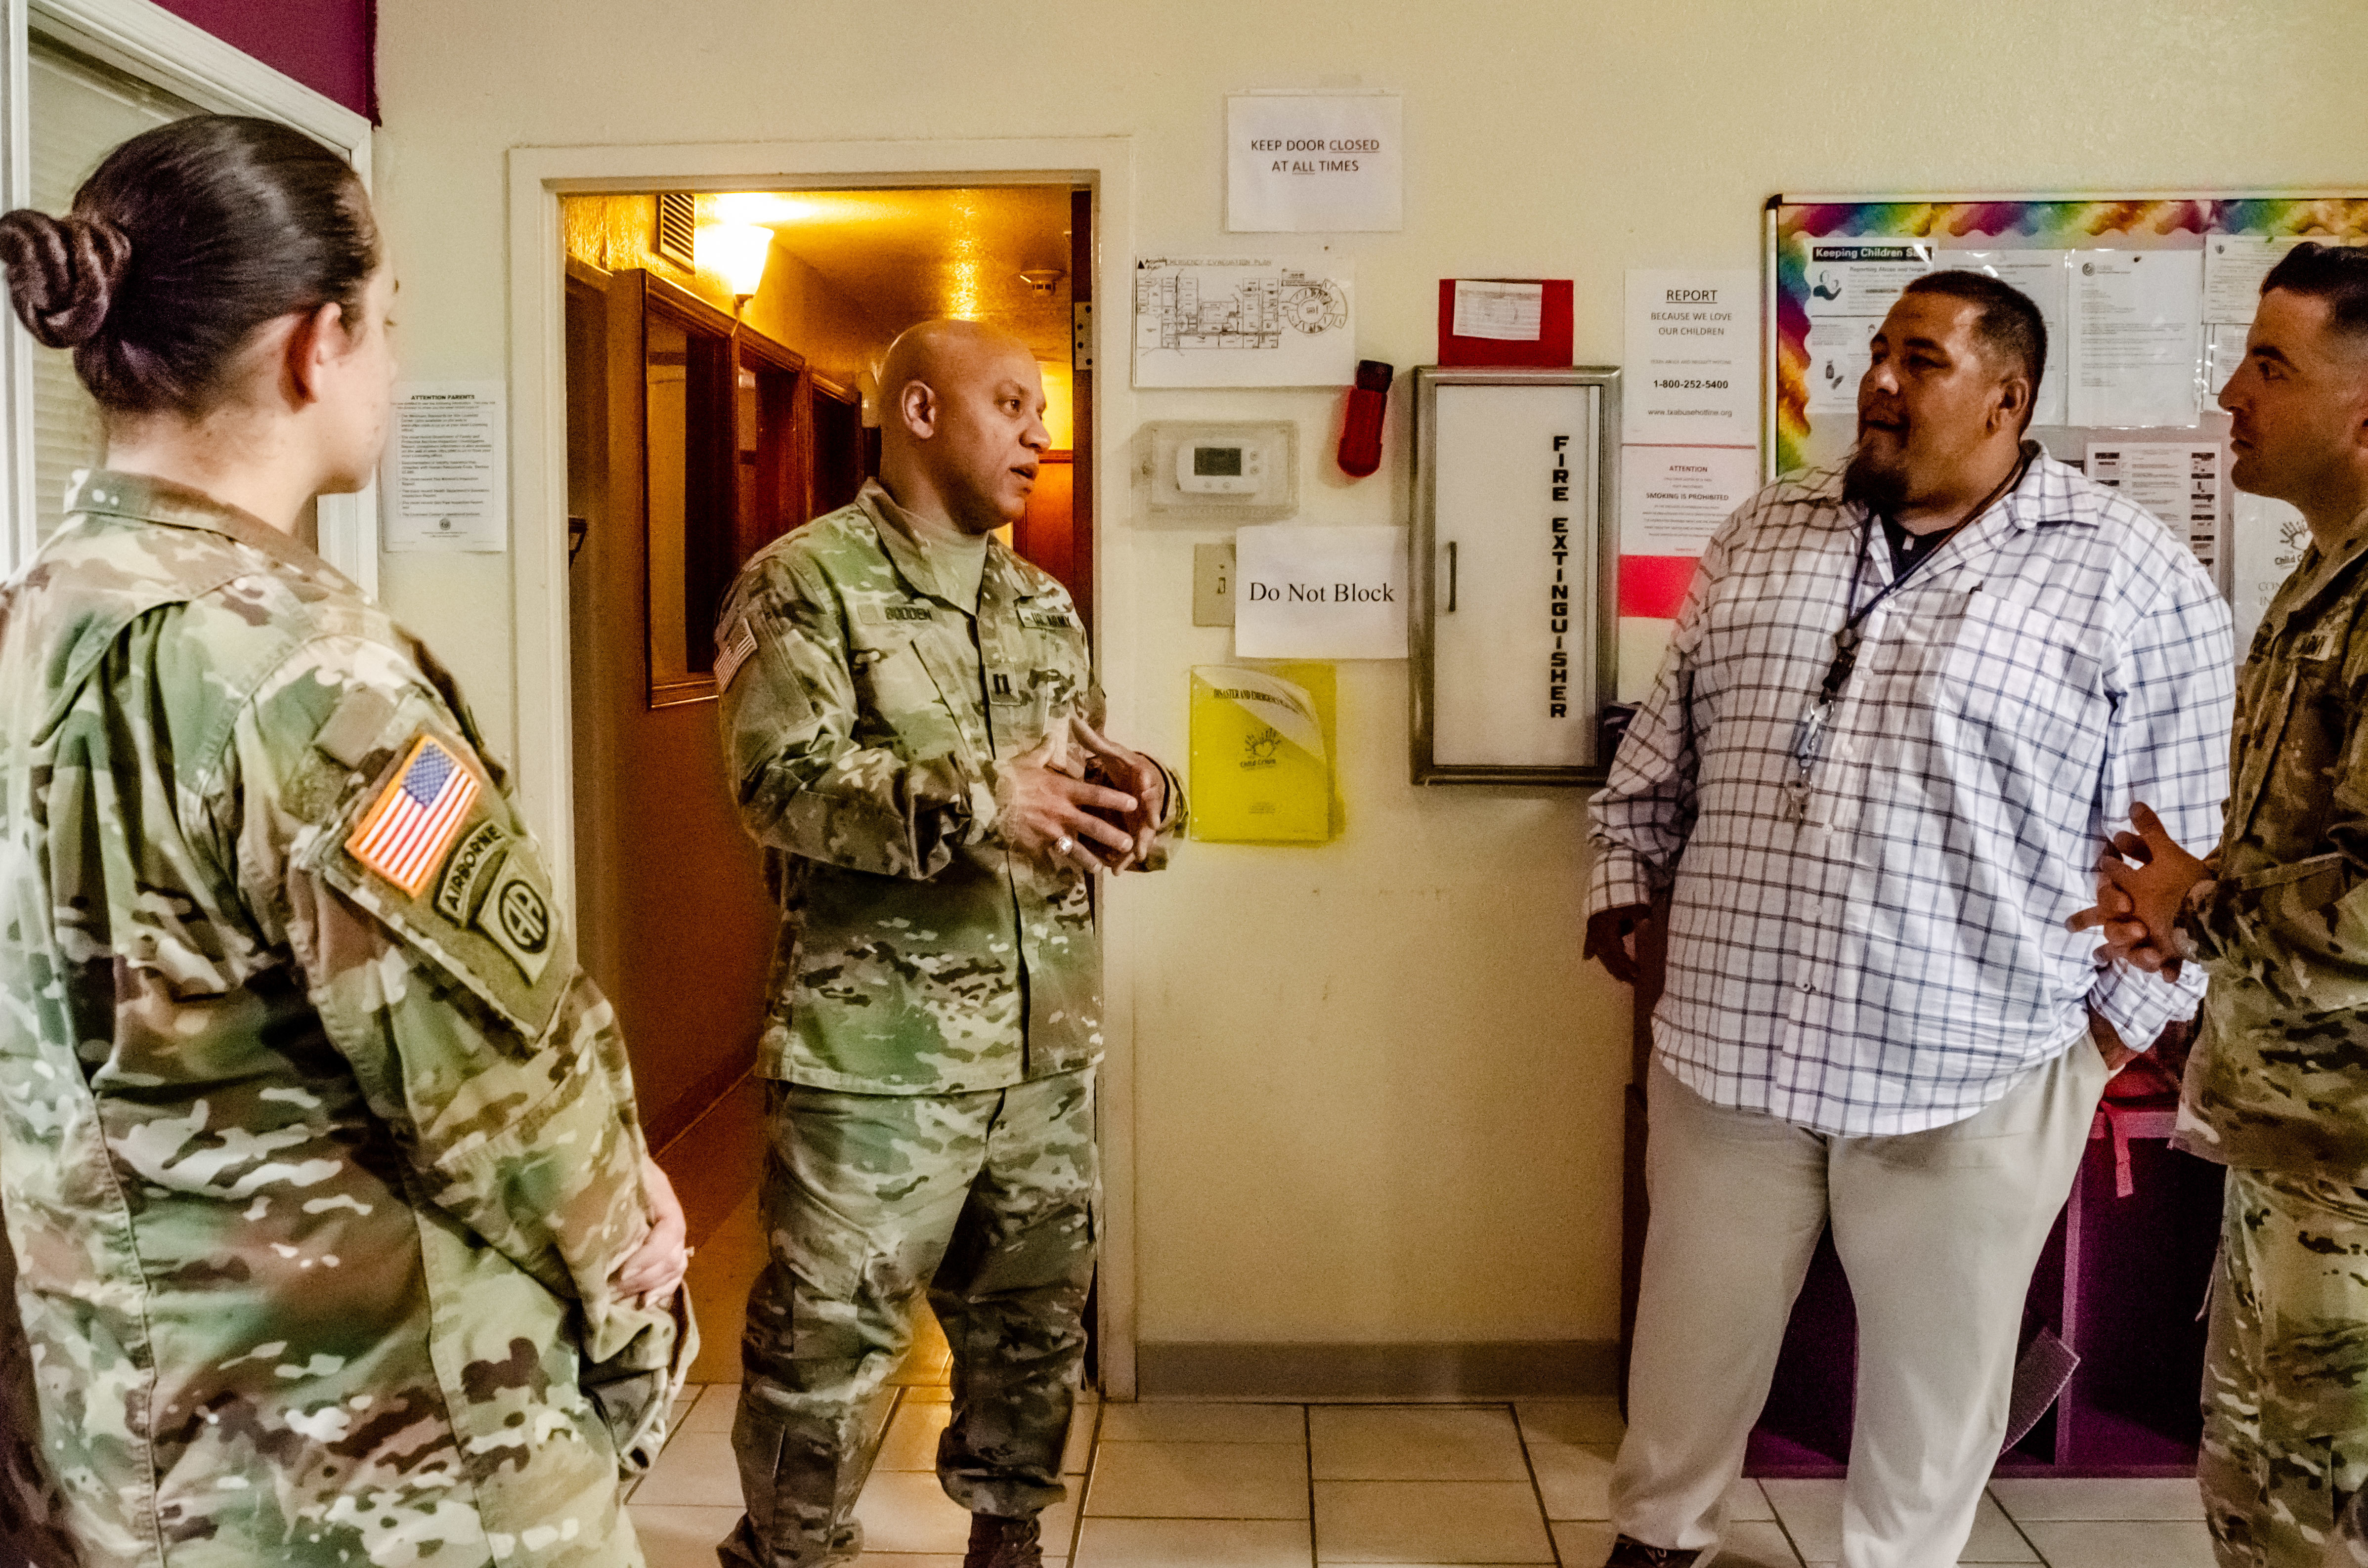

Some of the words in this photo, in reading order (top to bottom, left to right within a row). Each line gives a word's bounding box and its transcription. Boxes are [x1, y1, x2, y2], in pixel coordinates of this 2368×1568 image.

[1251, 140, 1282, 151] KEEP
[1287, 140, 1325, 151] DOOR
[1329, 139, 1380, 151] CLOSED
[1272, 161, 1289, 172] AT
[1292, 161, 1315, 172] ALL
[1319, 160, 1359, 172] TIMES
[1815, 248, 1858, 258] Keeping
[1860, 248, 1902, 257] Children
[1666, 290, 1718, 301] REPORT
[1654, 380, 1728, 388] 1-800-252-5400
[1552, 435, 1569, 501] FIRE
[1249, 582, 1280, 601] Do
[1288, 583, 1326, 602] Not
[1334, 583, 1394, 602] Block
[1550, 517, 1568, 718] EXTINGUISHER
